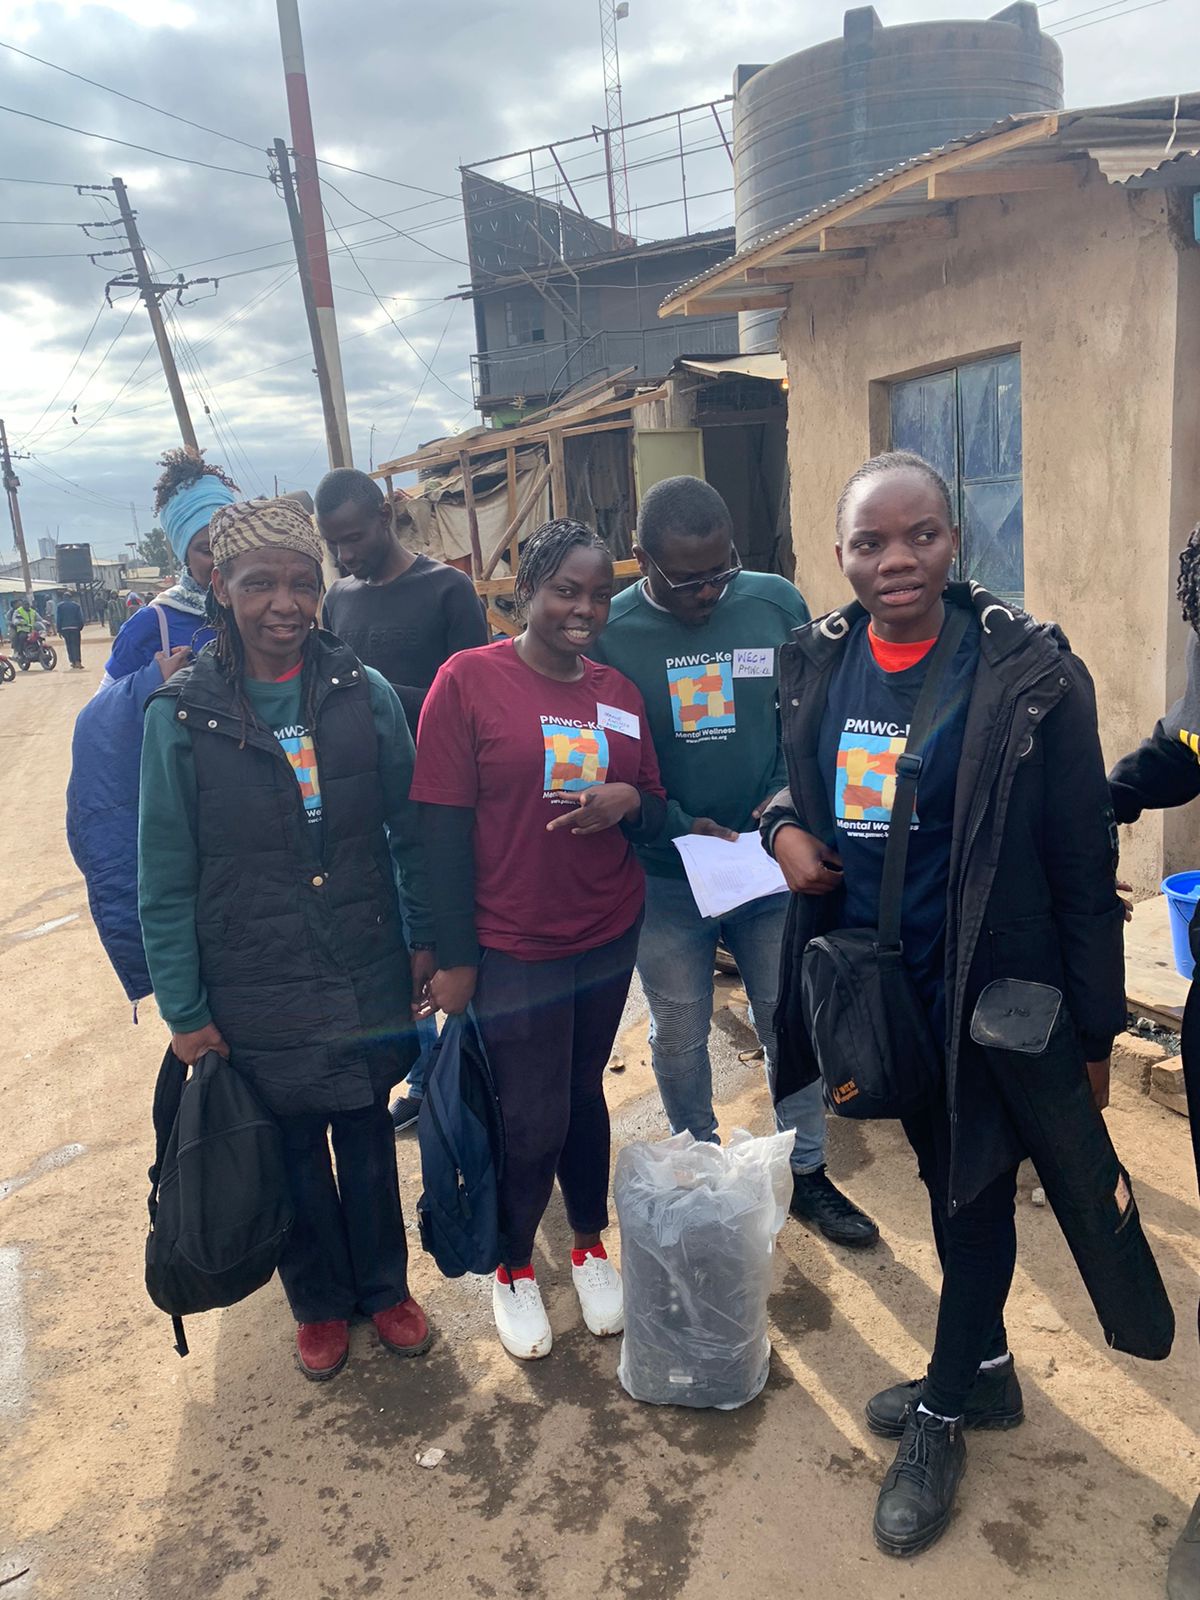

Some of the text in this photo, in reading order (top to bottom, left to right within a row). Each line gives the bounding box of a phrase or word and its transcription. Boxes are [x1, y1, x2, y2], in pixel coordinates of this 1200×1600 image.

[666, 651, 732, 669] PMWC-Ke
[675, 727, 736, 739] Mental Wellness
[836, 819, 872, 830] Mental
